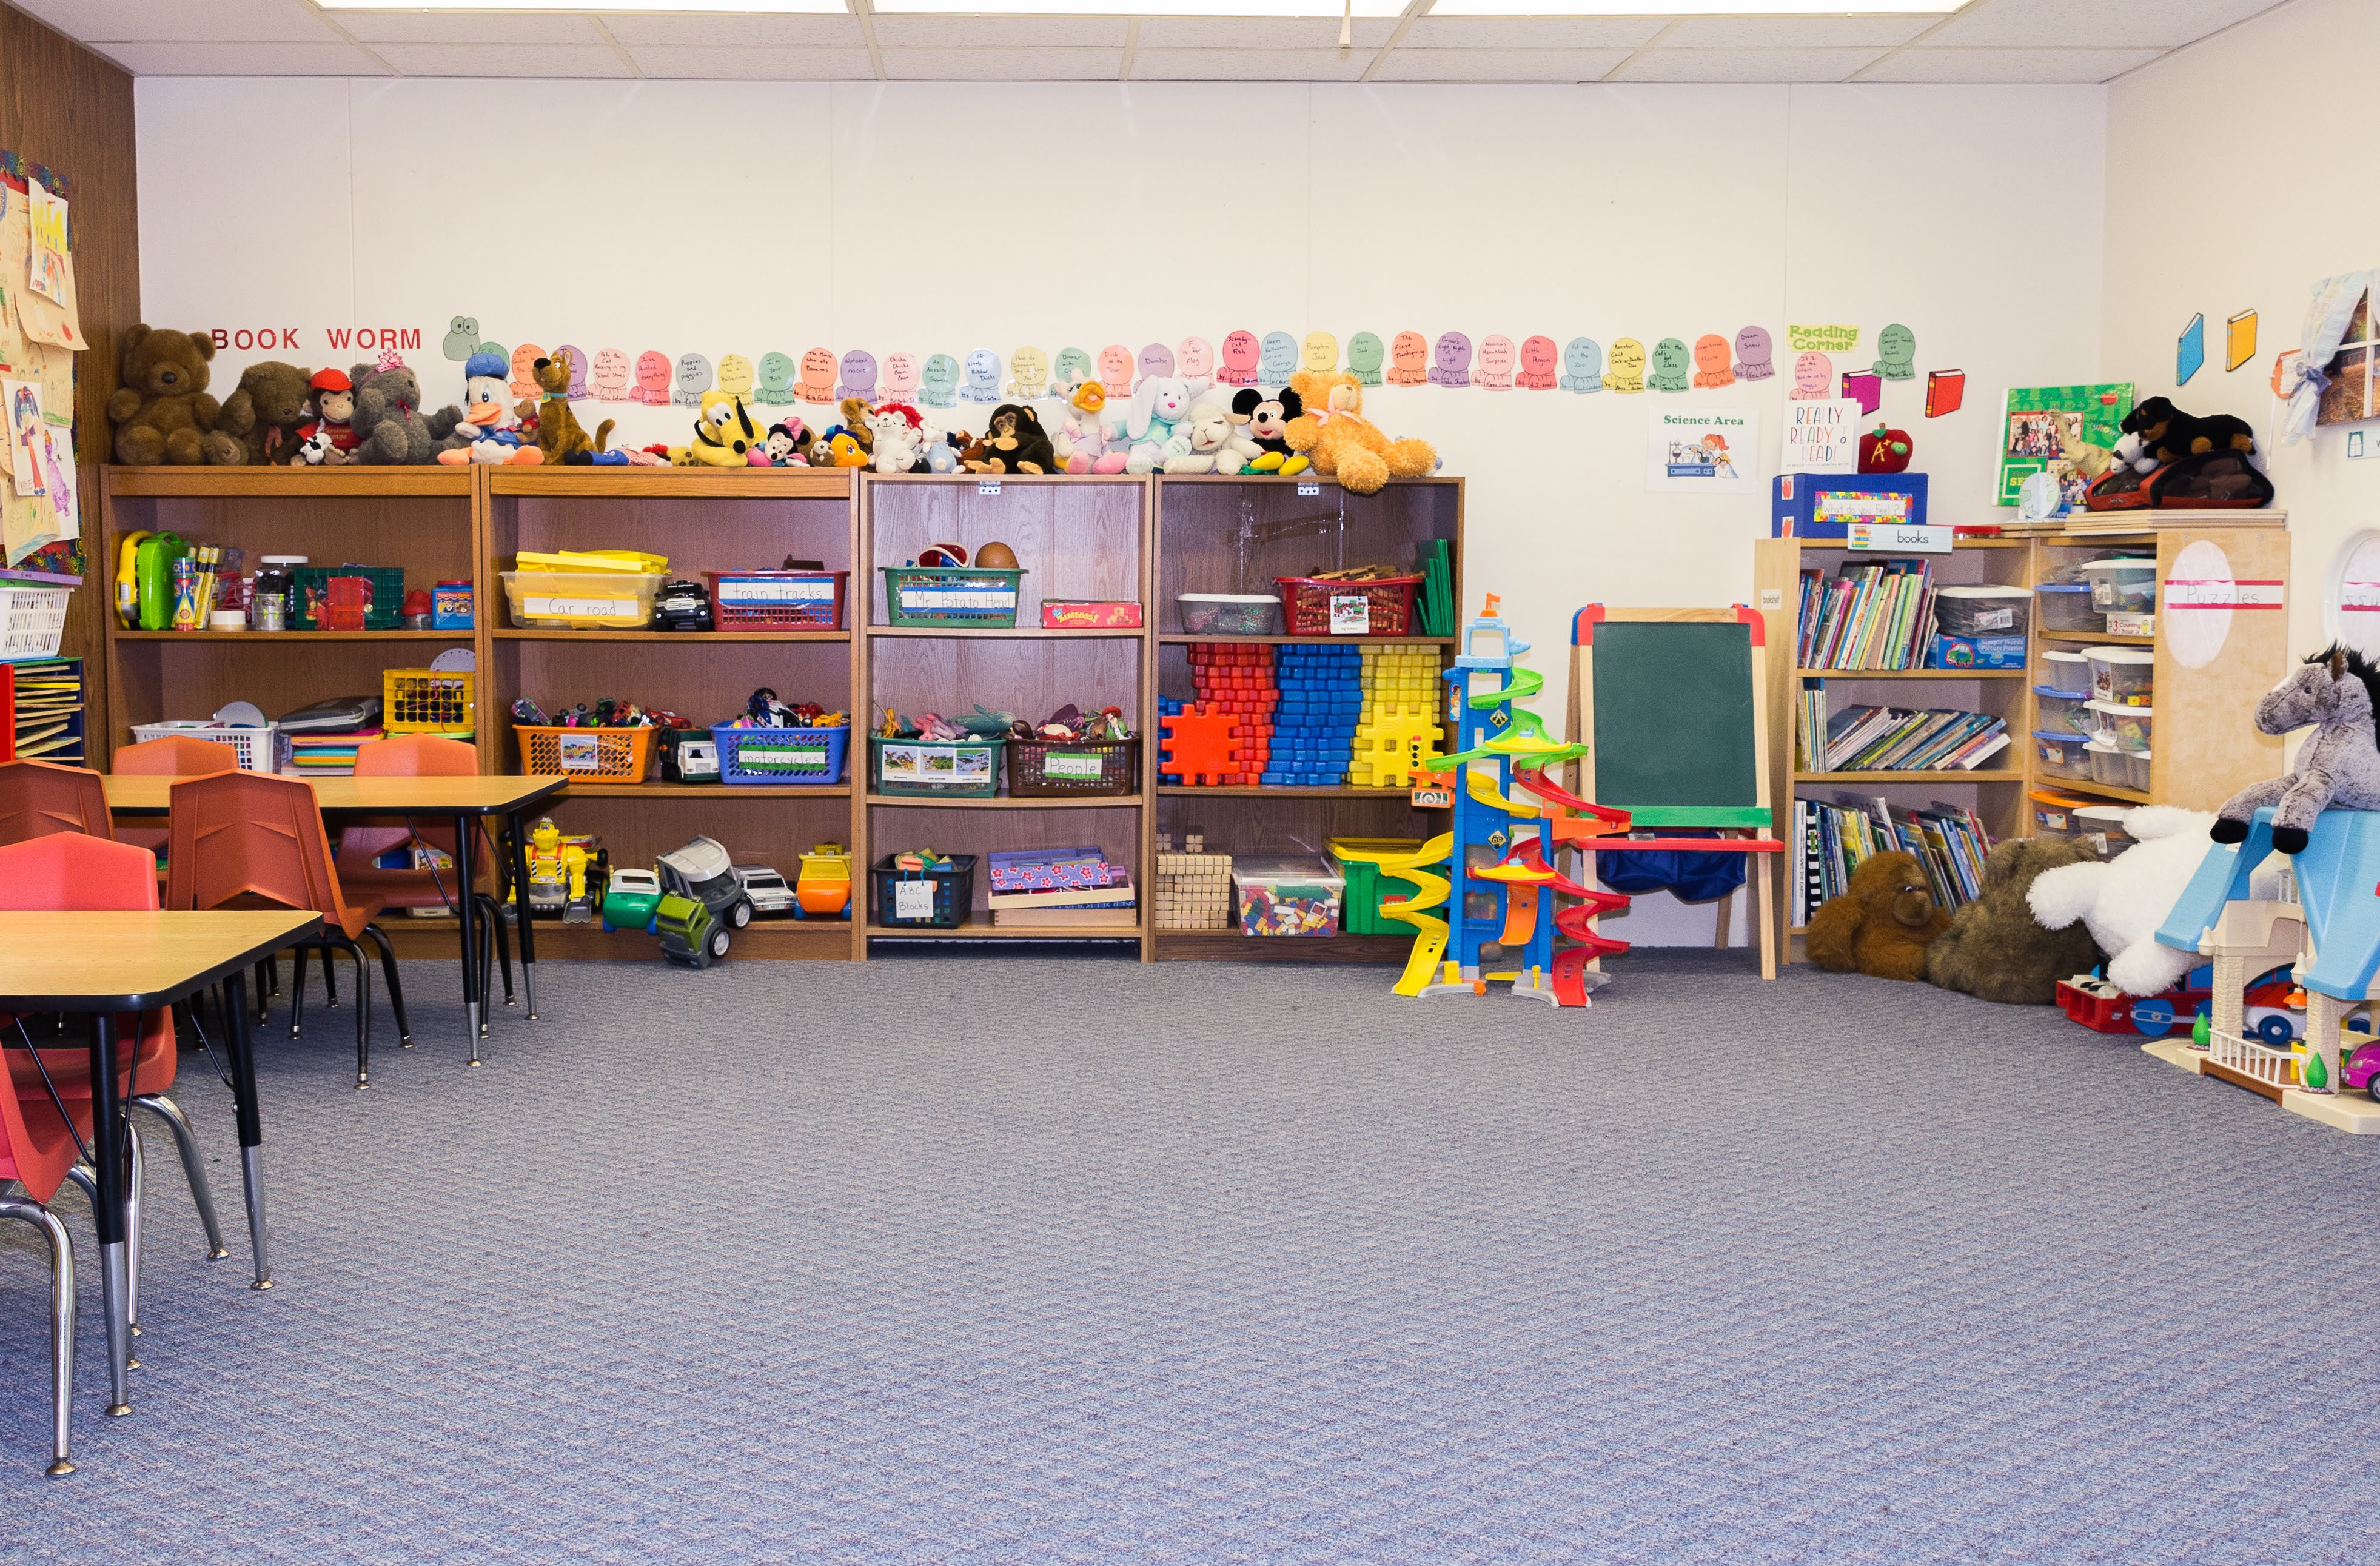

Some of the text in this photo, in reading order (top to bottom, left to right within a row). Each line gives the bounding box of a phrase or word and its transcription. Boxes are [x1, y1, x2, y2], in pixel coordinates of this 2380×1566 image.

[212, 328, 421, 350] BOOK WORM
[1789, 325, 1858, 341] Reading
[1793, 338, 1854, 351] Corner
[1664, 415, 1745, 426] Science Area
[1797, 407, 1843, 424] REALLY
[1791, 426, 1834, 444] READY
[1823, 503, 1843, 514] What
[1847, 504, 1855, 514] do
[1859, 507, 1872, 517] you
[1875, 504, 1891, 515] feel
[1897, 530, 1929, 544] books
[732, 583, 823, 601] train tracks
[941, 592, 979, 609] Potato
[985, 591, 1010, 609] Head
[1763, 594, 1780, 604] bookshelf
[2187, 584, 2260, 604] Puzzles
[548, 598, 616, 617] Car road
[743, 746, 820, 765] motorcycles
[1050, 757, 1097, 779] People
[899, 886, 921, 896] ABC
[899, 900, 930, 911] Blocks
